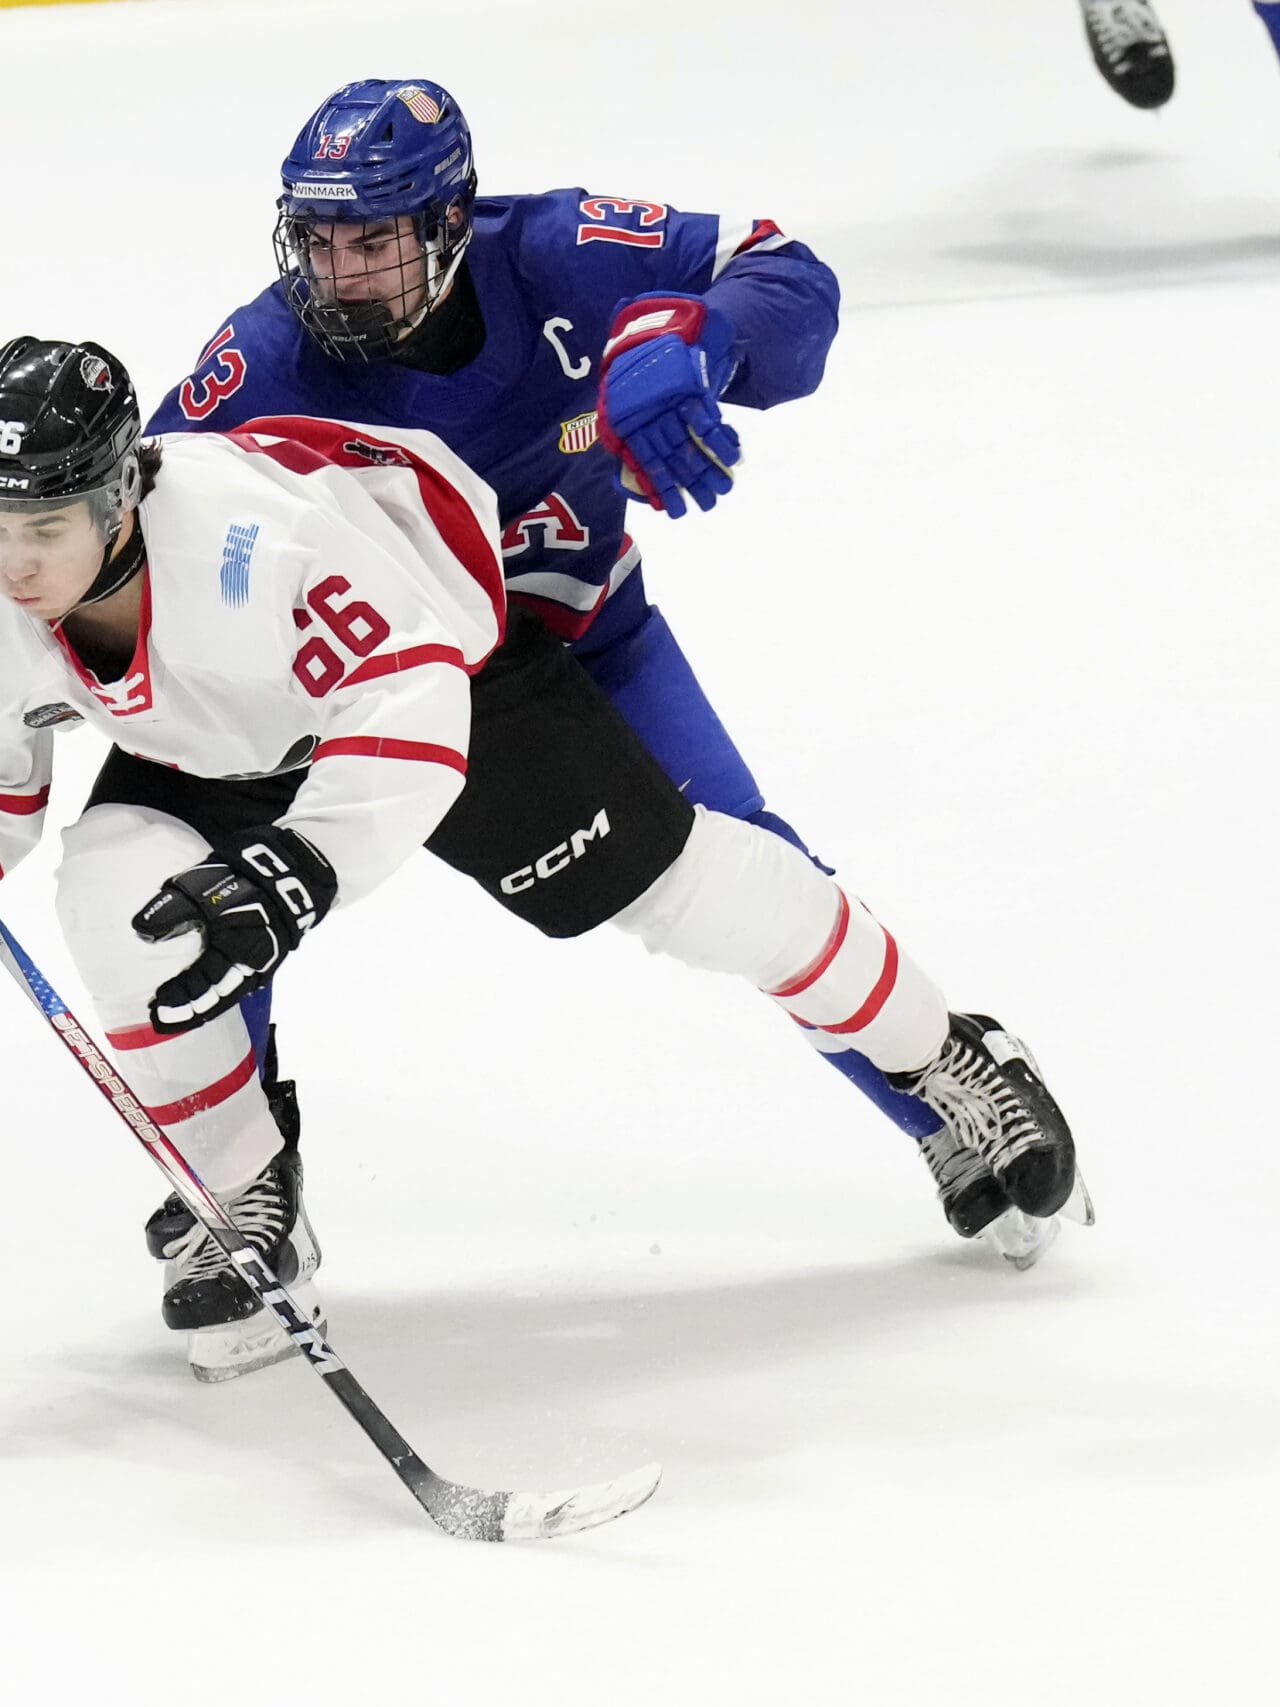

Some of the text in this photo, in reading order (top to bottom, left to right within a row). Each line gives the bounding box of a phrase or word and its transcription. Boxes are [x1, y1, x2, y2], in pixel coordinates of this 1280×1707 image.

[293, 184, 355, 198] WINMARK
[312, 134, 353, 160] 13
[576, 198, 668, 249] 13
[179, 324, 247, 421] 13
[543, 316, 591, 380] C
[291, 575, 391, 698] 66
[500, 807, 612, 895] CCM
[48, 1011, 161, 1145] JETSPEED
[231, 1247, 347, 1378] CCM
